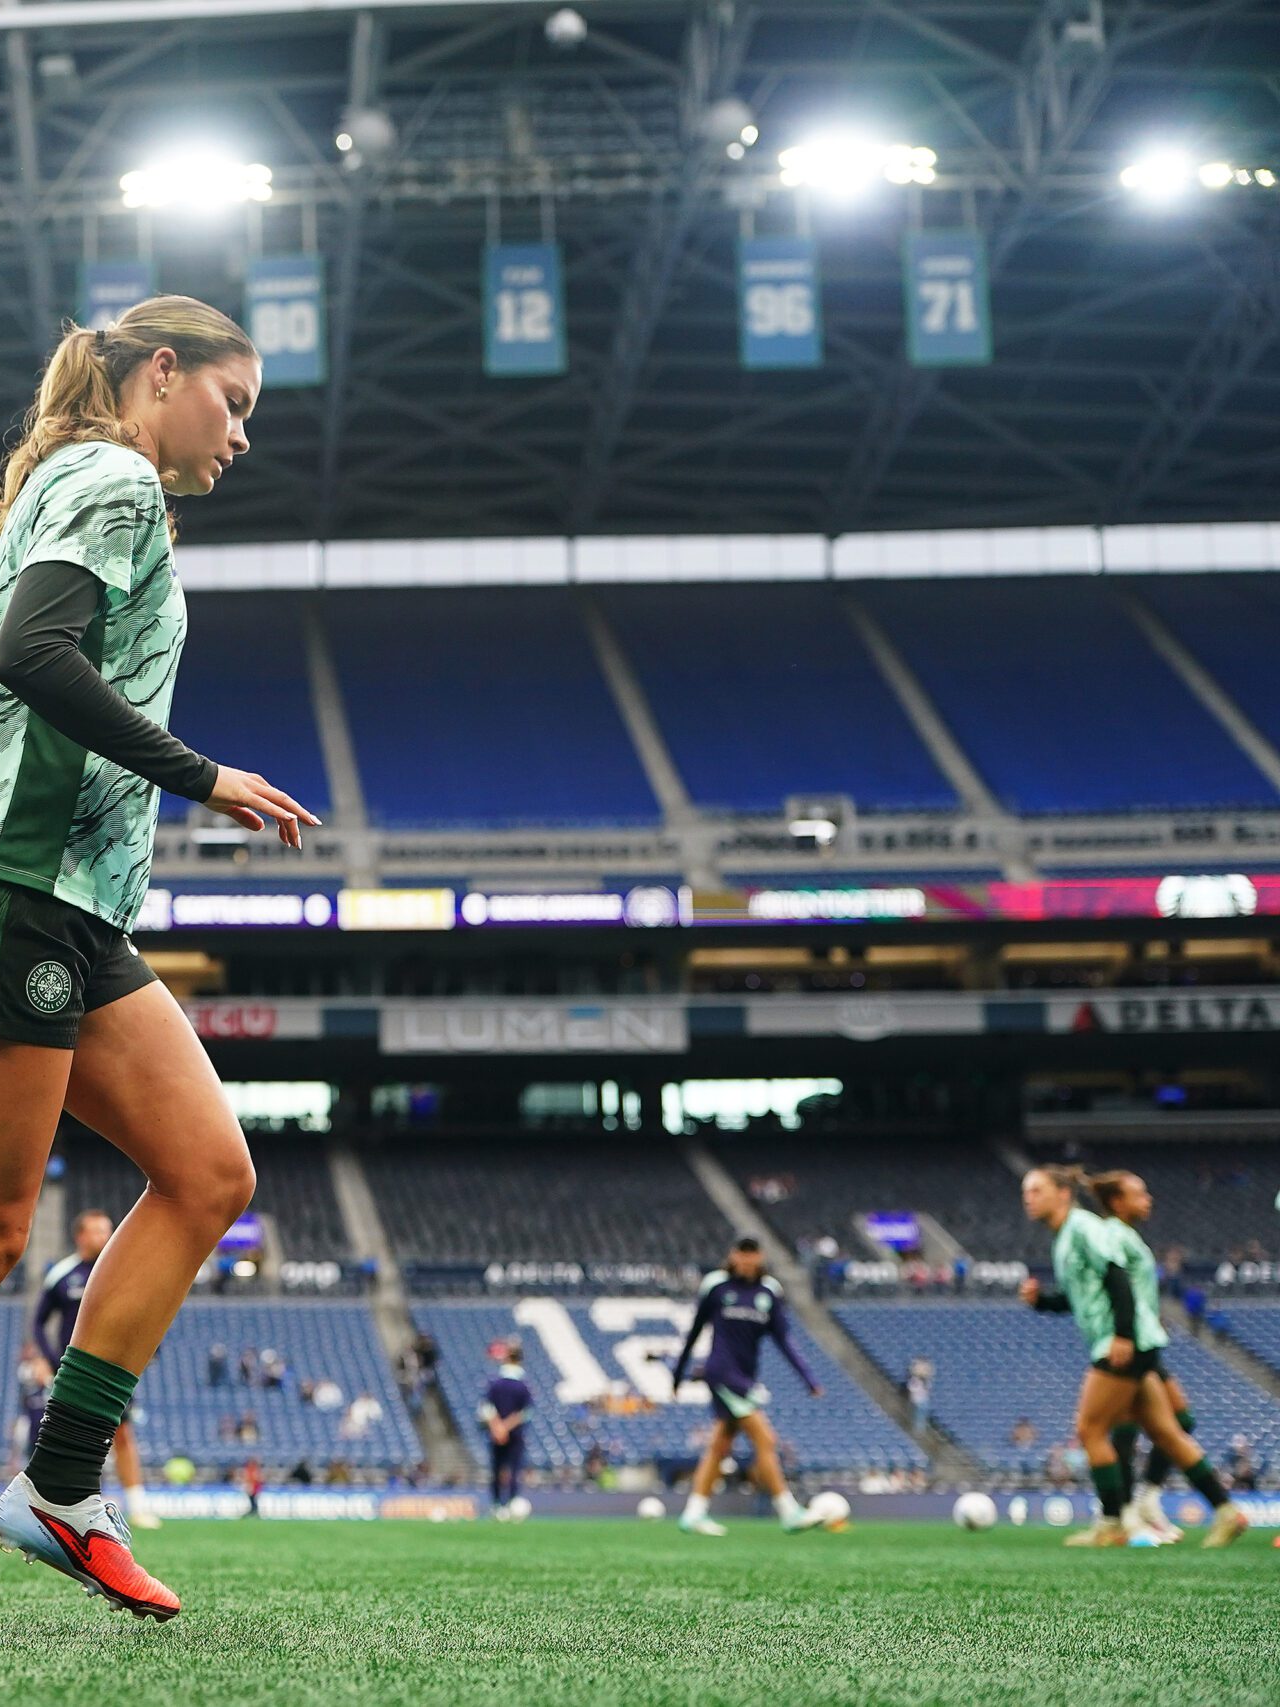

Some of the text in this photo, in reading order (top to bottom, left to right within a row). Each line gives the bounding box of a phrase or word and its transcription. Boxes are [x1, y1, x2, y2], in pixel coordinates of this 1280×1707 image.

[250, 301, 319, 353] 80
[496, 289, 553, 342] 12
[746, 283, 815, 337] 96
[919, 280, 976, 334] 71
[29, 964, 70, 992] RACING LOUISVILLE
[30, 989, 67, 1009] FOOTBALL CLUB
[403, 1005, 665, 1048] LUMEN
[1120, 998, 1274, 1032] DELTA
[514, 1297, 715, 1405] 12
